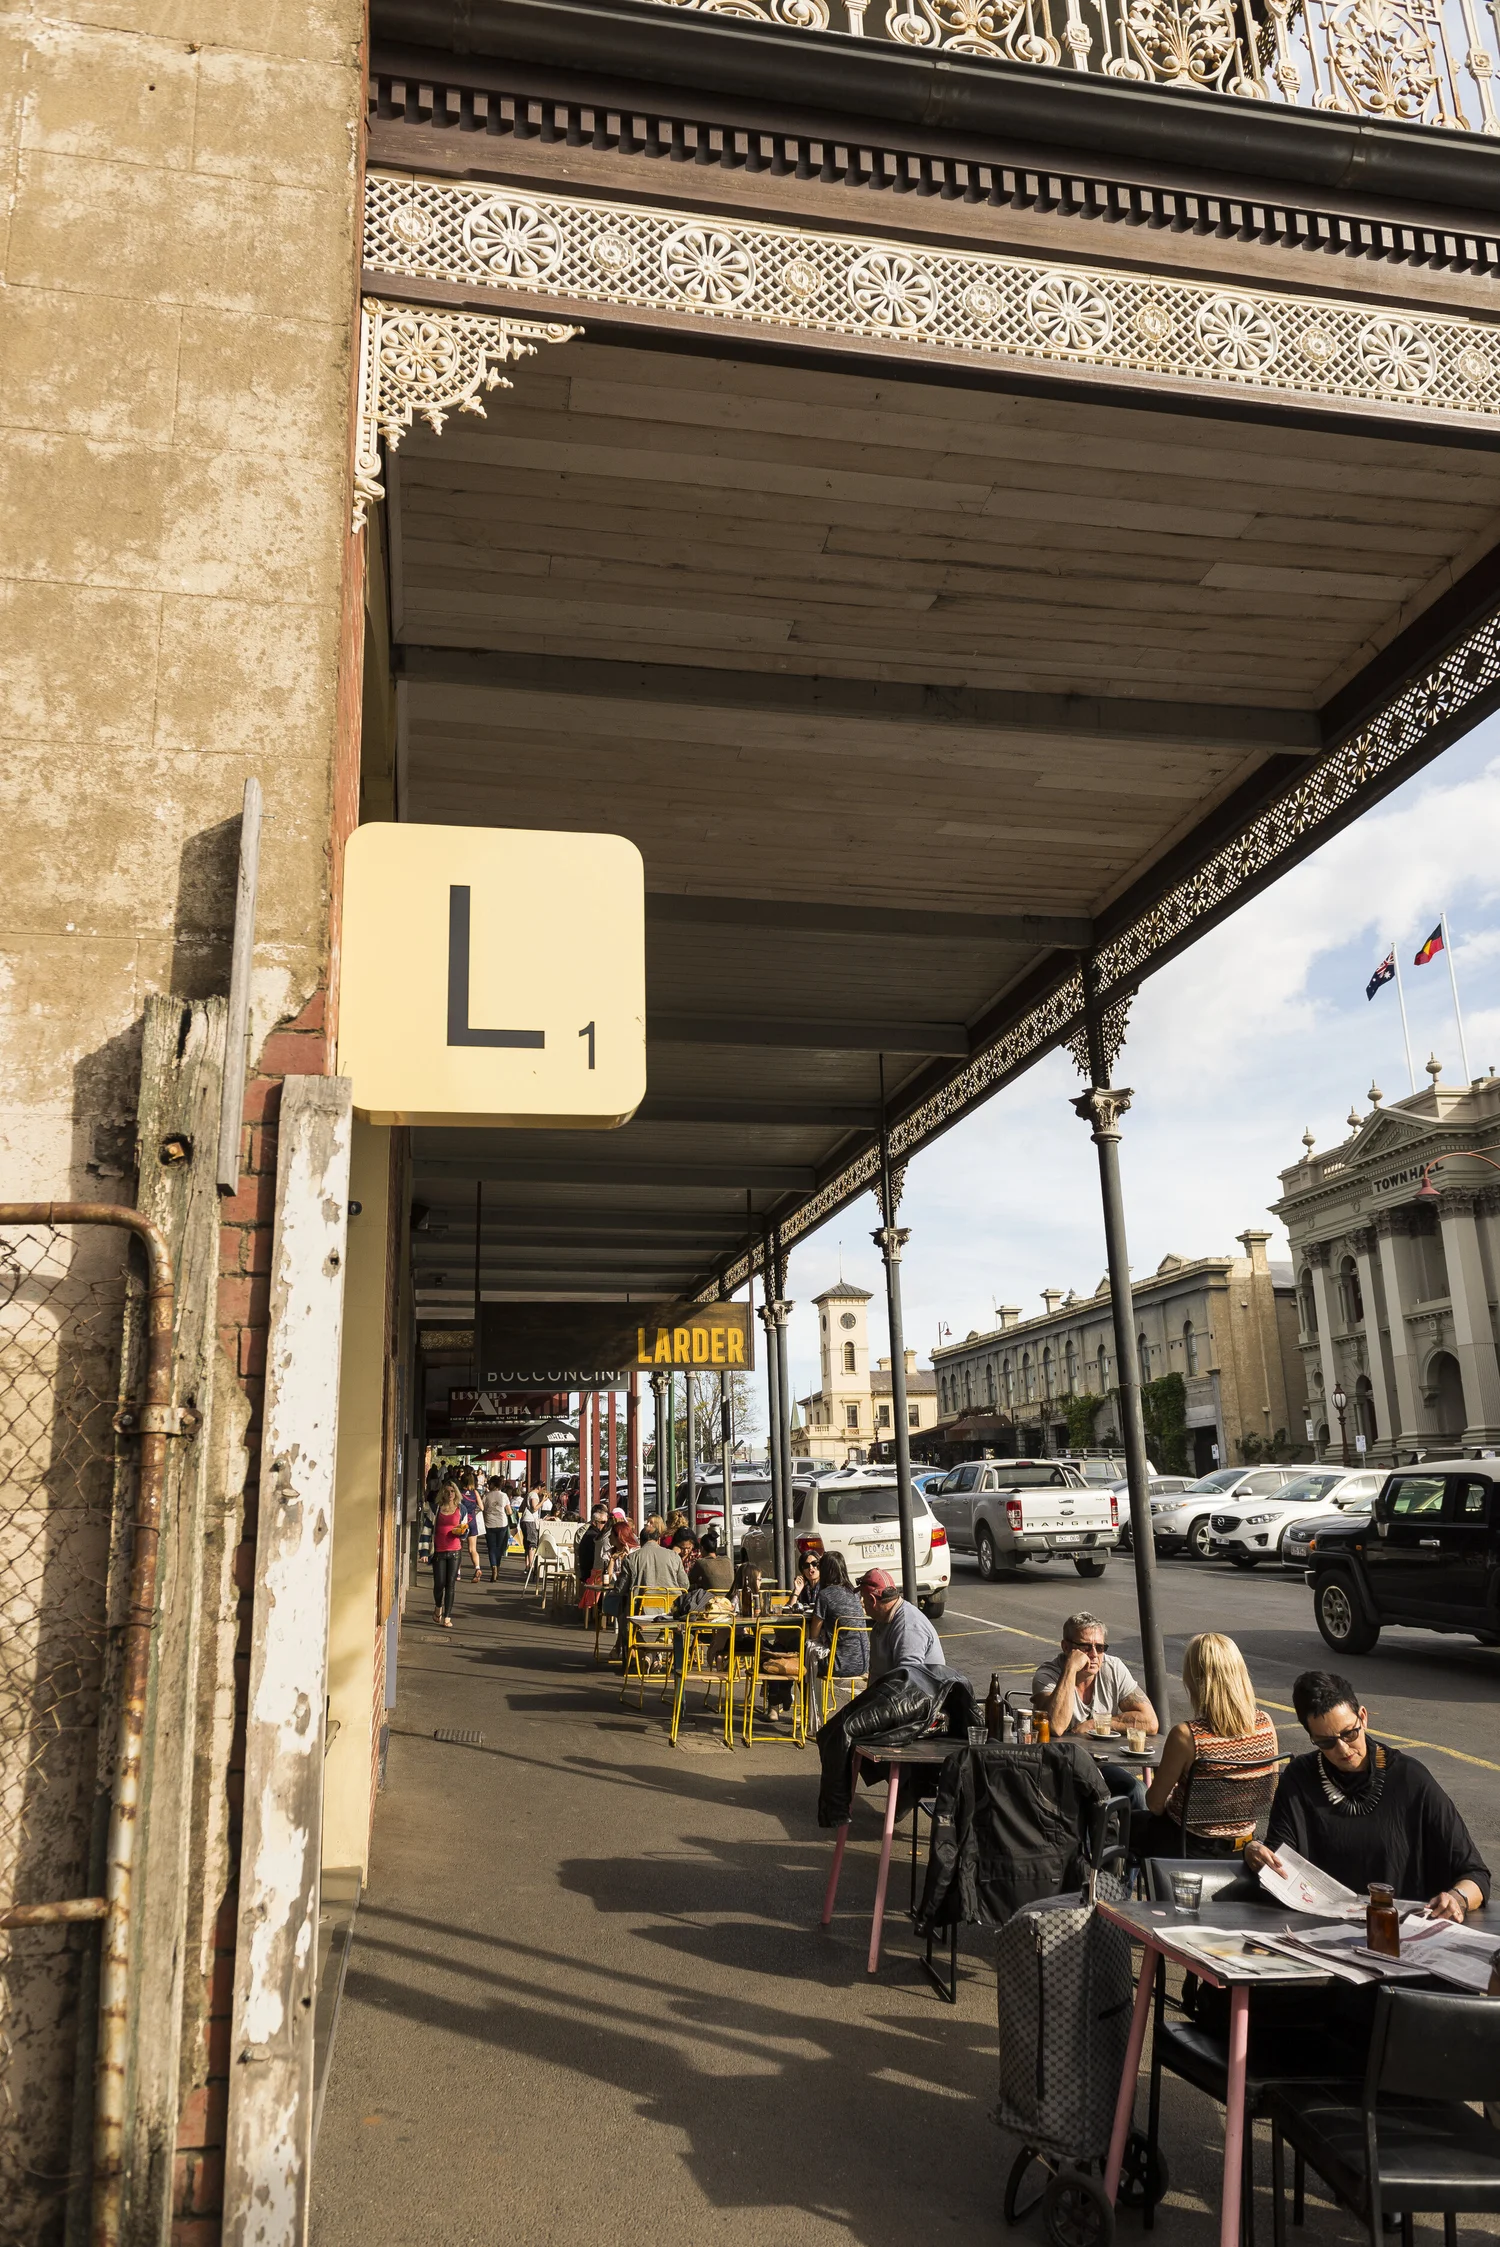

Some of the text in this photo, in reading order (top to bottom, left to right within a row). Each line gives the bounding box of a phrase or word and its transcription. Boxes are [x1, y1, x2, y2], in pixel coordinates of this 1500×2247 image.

[447, 885, 595, 1070] L 1
[1374, 1162, 1444, 1192] TOWN HALL
[637, 1327, 745, 1364] LARDER
[1026, 1520, 1108, 1528] RANGER
